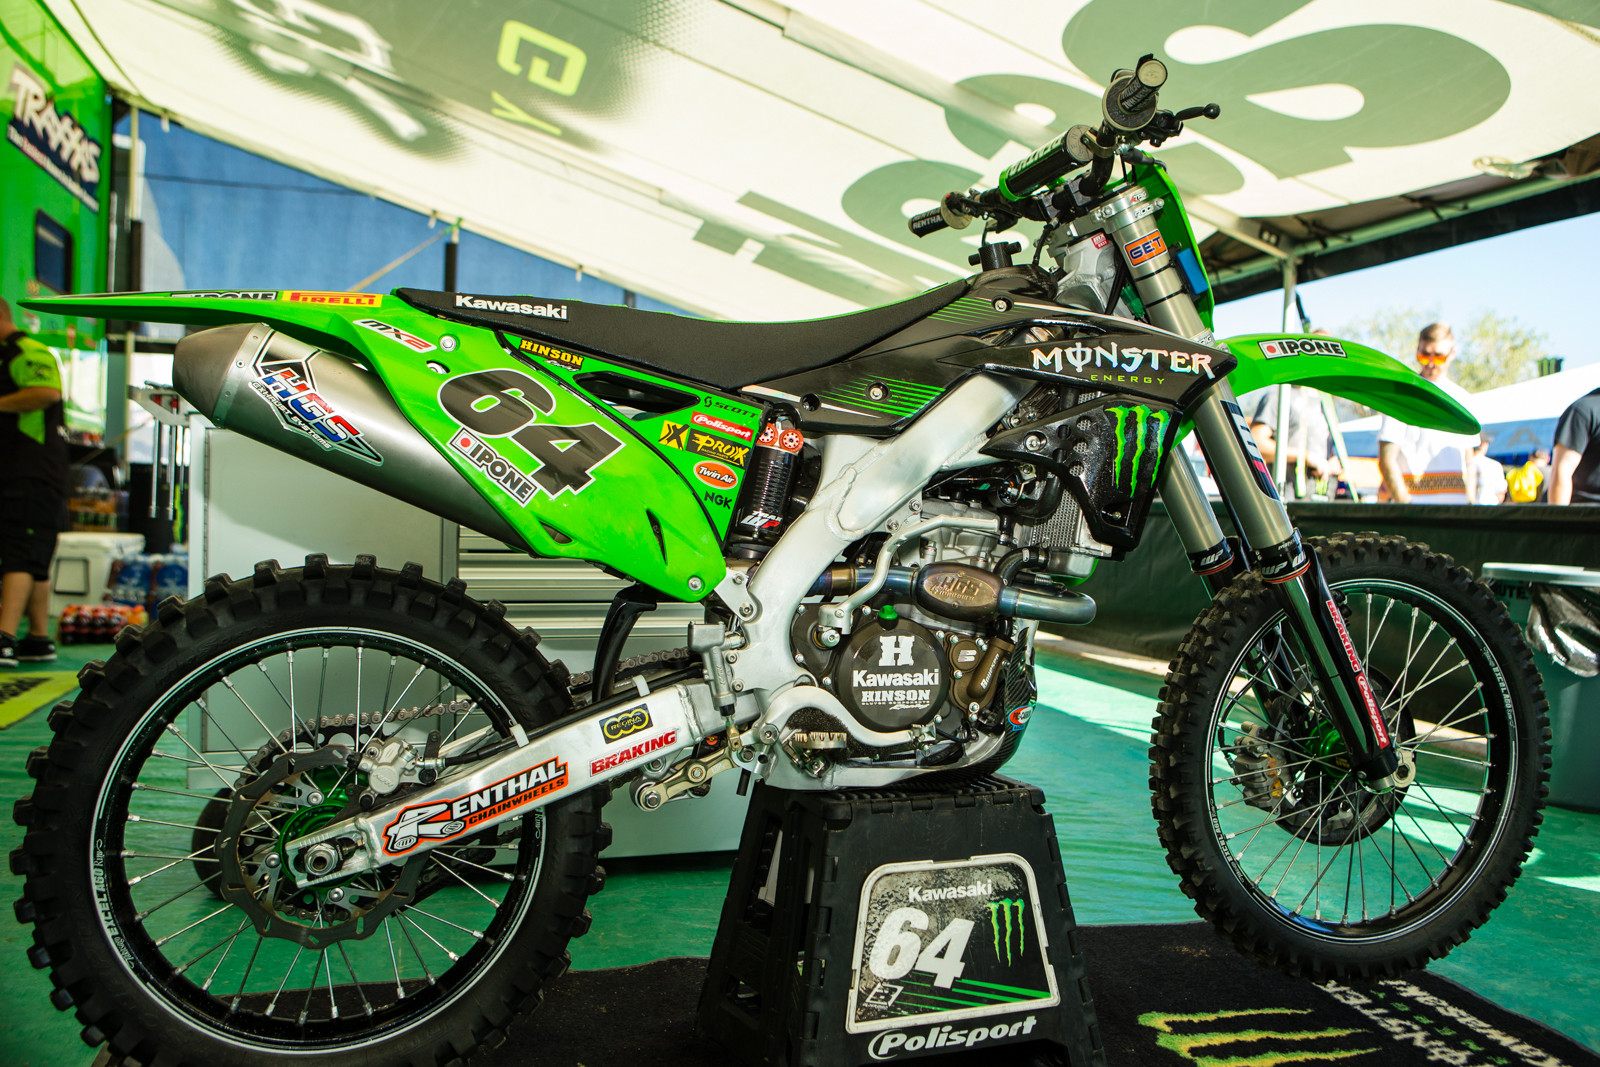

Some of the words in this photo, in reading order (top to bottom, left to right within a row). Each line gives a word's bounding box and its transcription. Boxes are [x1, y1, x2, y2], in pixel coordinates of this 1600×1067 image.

[12, 67, 102, 184] TRAXXAS
[912, 213, 944, 229] RENTHA
[1129, 236, 1161, 260] GET
[290, 292, 375, 305] PIRELLI
[455, 294, 568, 320] Kawasaki
[519, 338, 584, 366] HINSON
[1031, 341, 1217, 380] MONSTER
[1281, 339, 1346, 356] IPONE
[1090, 374, 1166, 386] ENERGY
[261, 368, 361, 442] HGS
[712, 401, 759, 419] SCOTT
[437, 367, 627, 500] 64
[692, 413, 752, 438] Polisport
[469, 442, 533, 500] IPONE
[699, 465, 721, 480] Twin
[719, 473, 735, 485] Air
[703, 490, 733, 510] NGK
[1326, 600, 1361, 673] BRAKING
[852, 668, 940, 688] Kawasaki
[861, 689, 931, 702] HINSON
[1357, 675, 1388, 744] Polisport
[610, 715, 642, 731] REGINA
[591, 730, 677, 776] BRAKING
[468, 777, 566, 826] CHAINWHEELS
[908, 879, 992, 902] Kawasaki
[99, 890, 120, 938] EXCEL
[868, 906, 976, 990] 64
[867, 1014, 1038, 1060] Polisport
